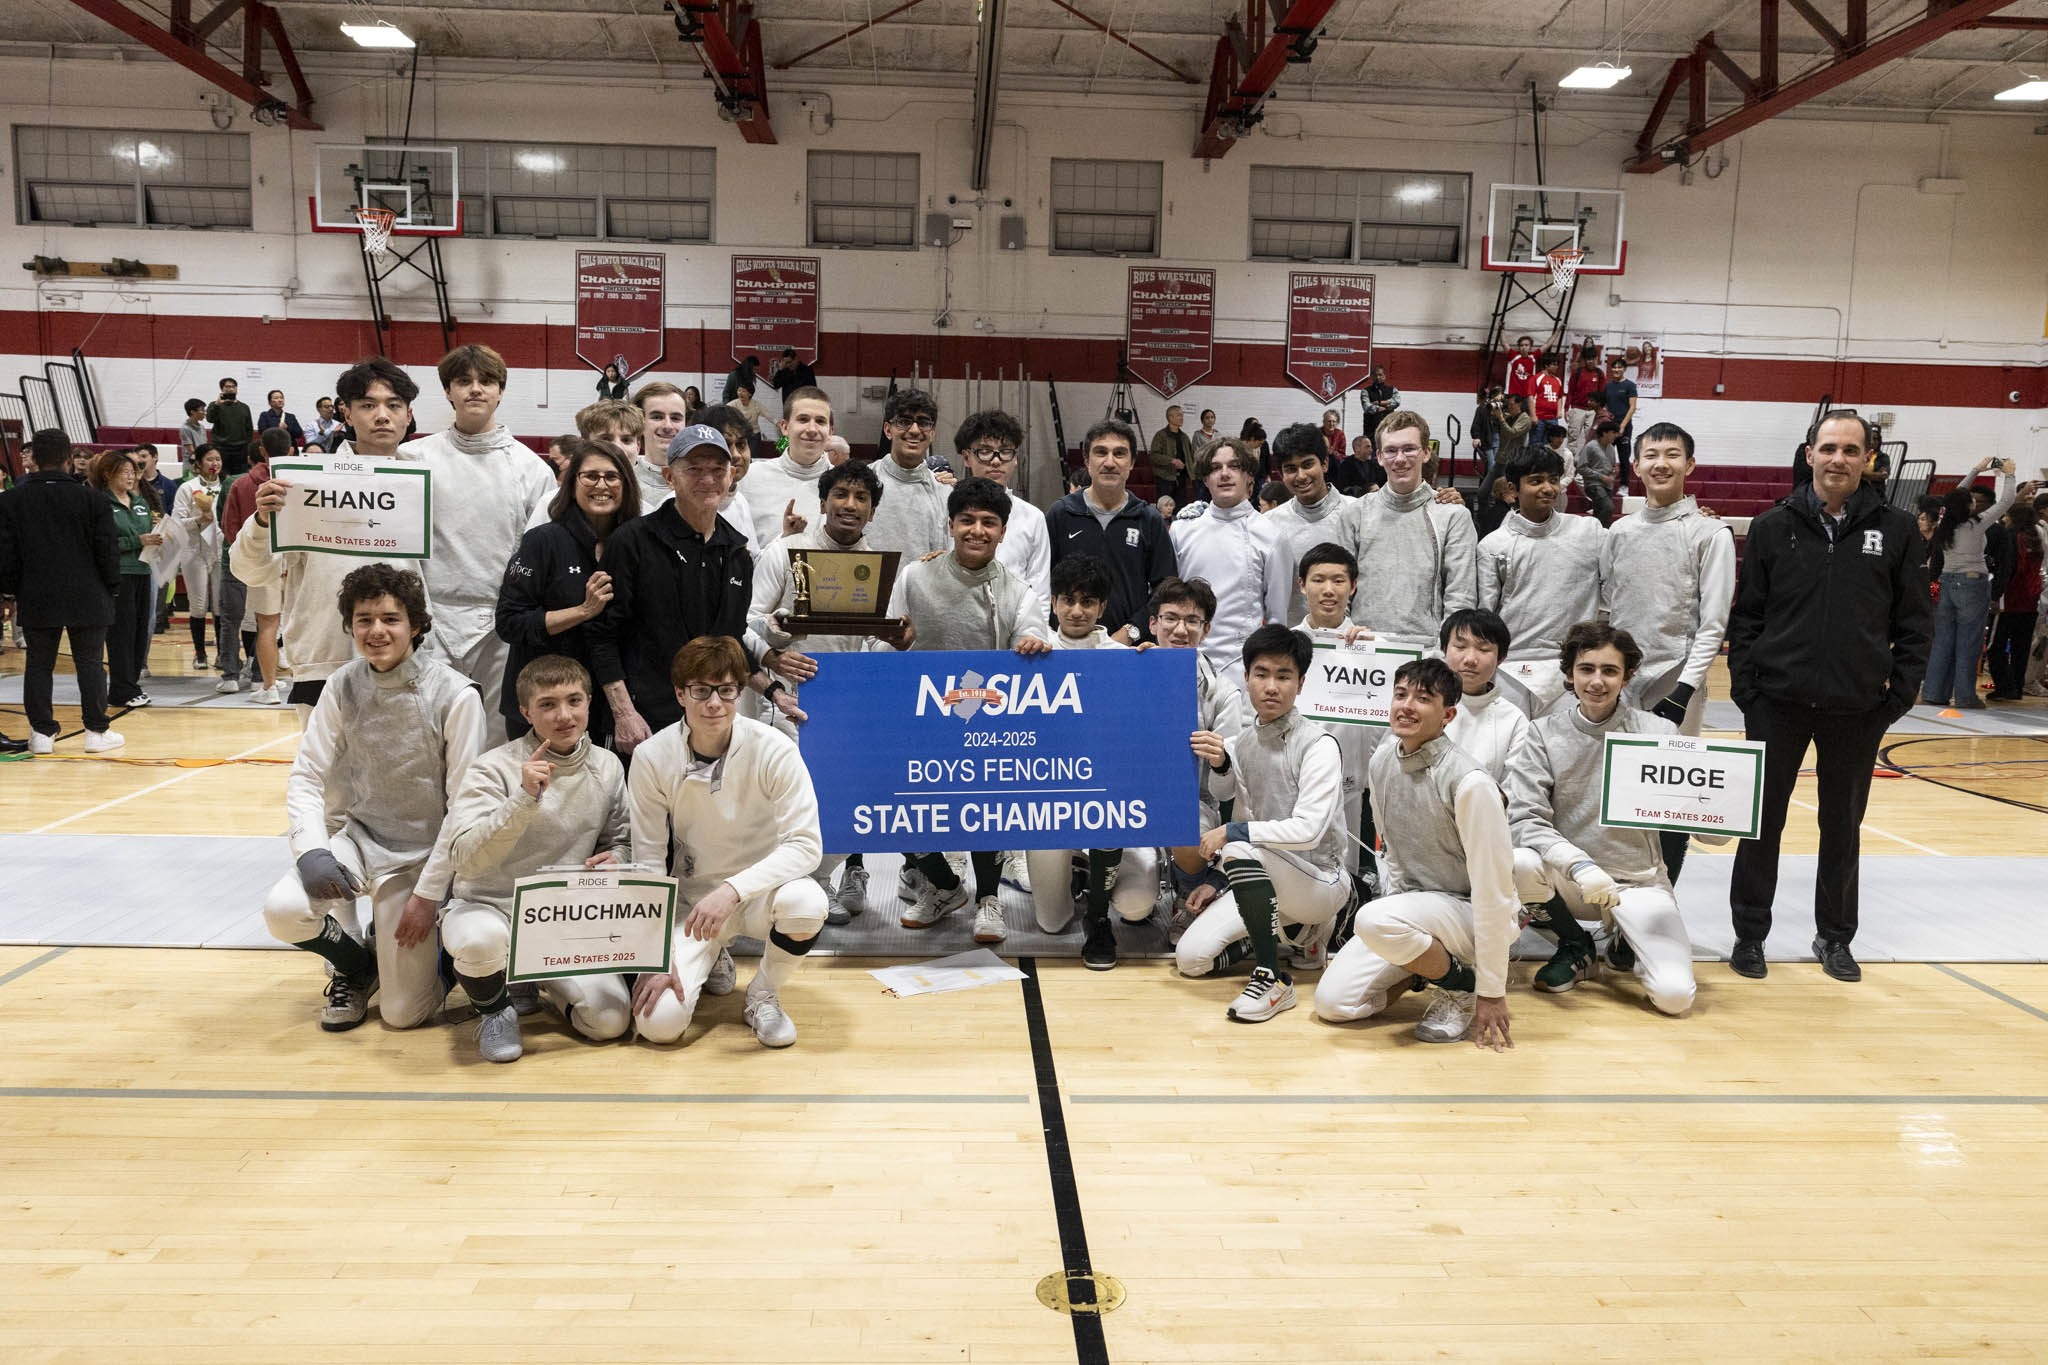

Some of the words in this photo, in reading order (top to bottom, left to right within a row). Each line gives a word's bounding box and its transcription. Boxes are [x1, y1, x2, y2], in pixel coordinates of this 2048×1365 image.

[580, 255, 596, 269] GIRLS
[597, 255, 620, 266] WINTER
[621, 256, 640, 266] TRACK
[645, 257, 661, 271] FIELD
[736, 259, 752, 273] GIRLS
[753, 260, 776, 270] WINTER
[776, 260, 795, 270] TRACK
[800, 261, 816, 275] FIELD
[580, 274, 660, 286] CHAMPIONS
[736, 279, 816, 290] CHAMPIONS
[1133, 271, 1155, 284] BOYS
[1158, 271, 1212, 287] WRESTLING
[1293, 275, 1319, 289] GIRLS
[1320, 276, 1371, 292] WRESTLING
[1132, 291, 1211, 301] CHAMPIONS
[1292, 295, 1370, 306] CHAMPIONS
[697, 426, 714, 439] NY
[334, 463, 363, 471] RIDGE
[303, 489, 396, 510] ZHANG
[374, 539, 397, 548] 2025
[1863, 530, 1883, 551] R
[1344, 643, 1367, 652] RIDGE
[1323, 665, 1386, 687] YANG
[1370, 708, 1389, 717] 2025
[963, 731, 1037, 748] 2024-2025
[1668, 740, 1697, 749] RIDGE
[907, 758, 976, 783] BOYS
[984, 756, 1093, 782] FENCING
[1640, 764, 1725, 789] RIDGE
[853, 803, 950, 835] STATE
[960, 799, 1147, 832] CHAMPIONS
[1701, 814, 1724, 824] 2025
[578, 878, 608, 886] RIDGE
[524, 903, 662, 924] SCHUCHMAN
[612, 952, 636, 961] 2025
